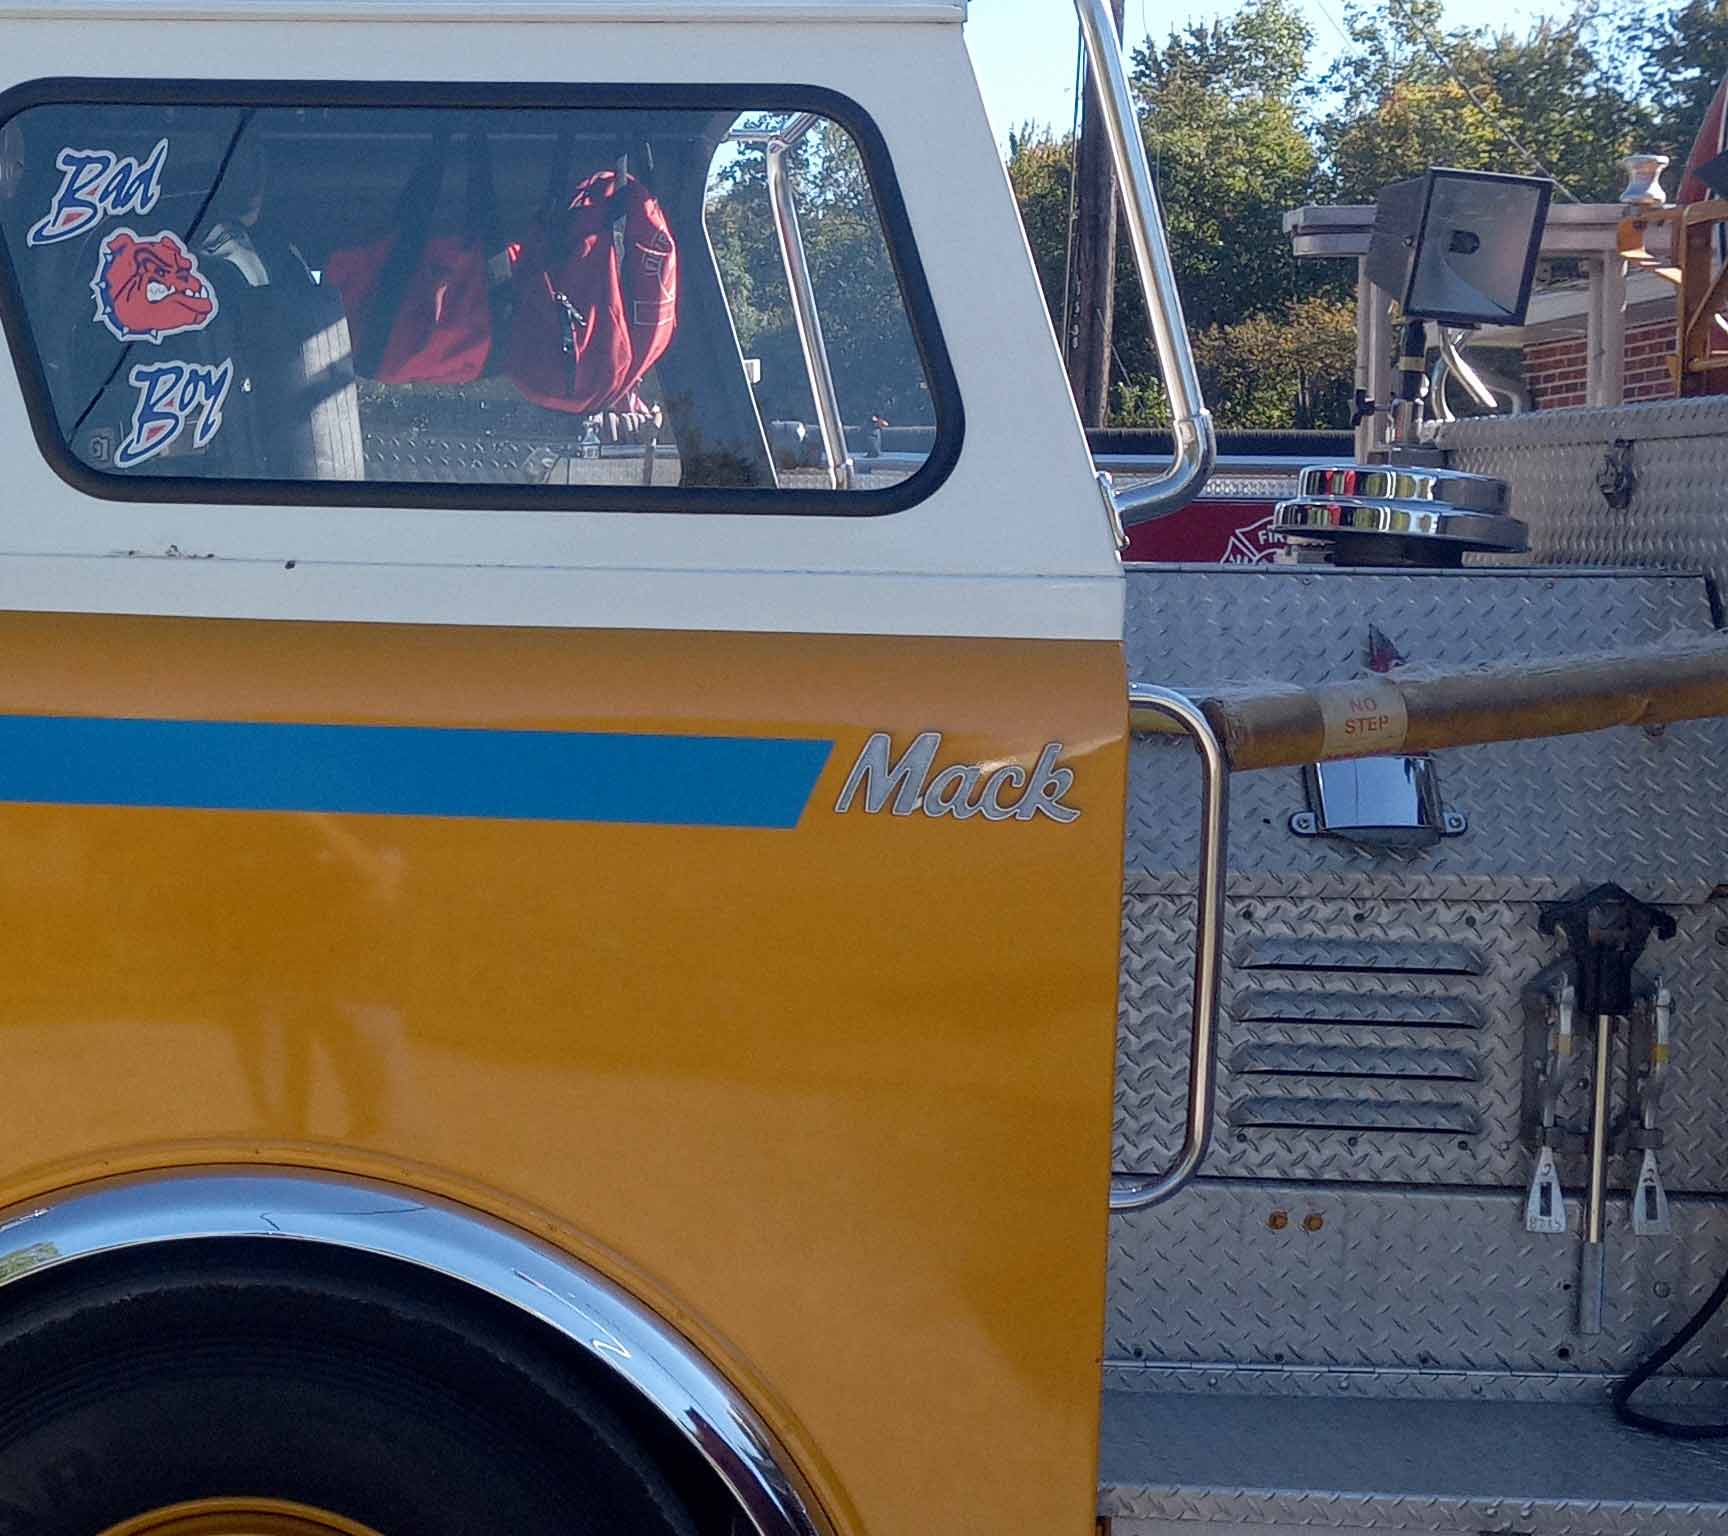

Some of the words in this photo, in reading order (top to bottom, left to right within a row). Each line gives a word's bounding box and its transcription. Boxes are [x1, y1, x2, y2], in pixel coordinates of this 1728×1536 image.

[28, 139, 168, 246] Bad
[116, 358, 232, 467] Boy
[1345, 714, 1391, 736] STEP
[1350, 697, 1377, 713] NO
[834, 732, 1081, 824] Mack
